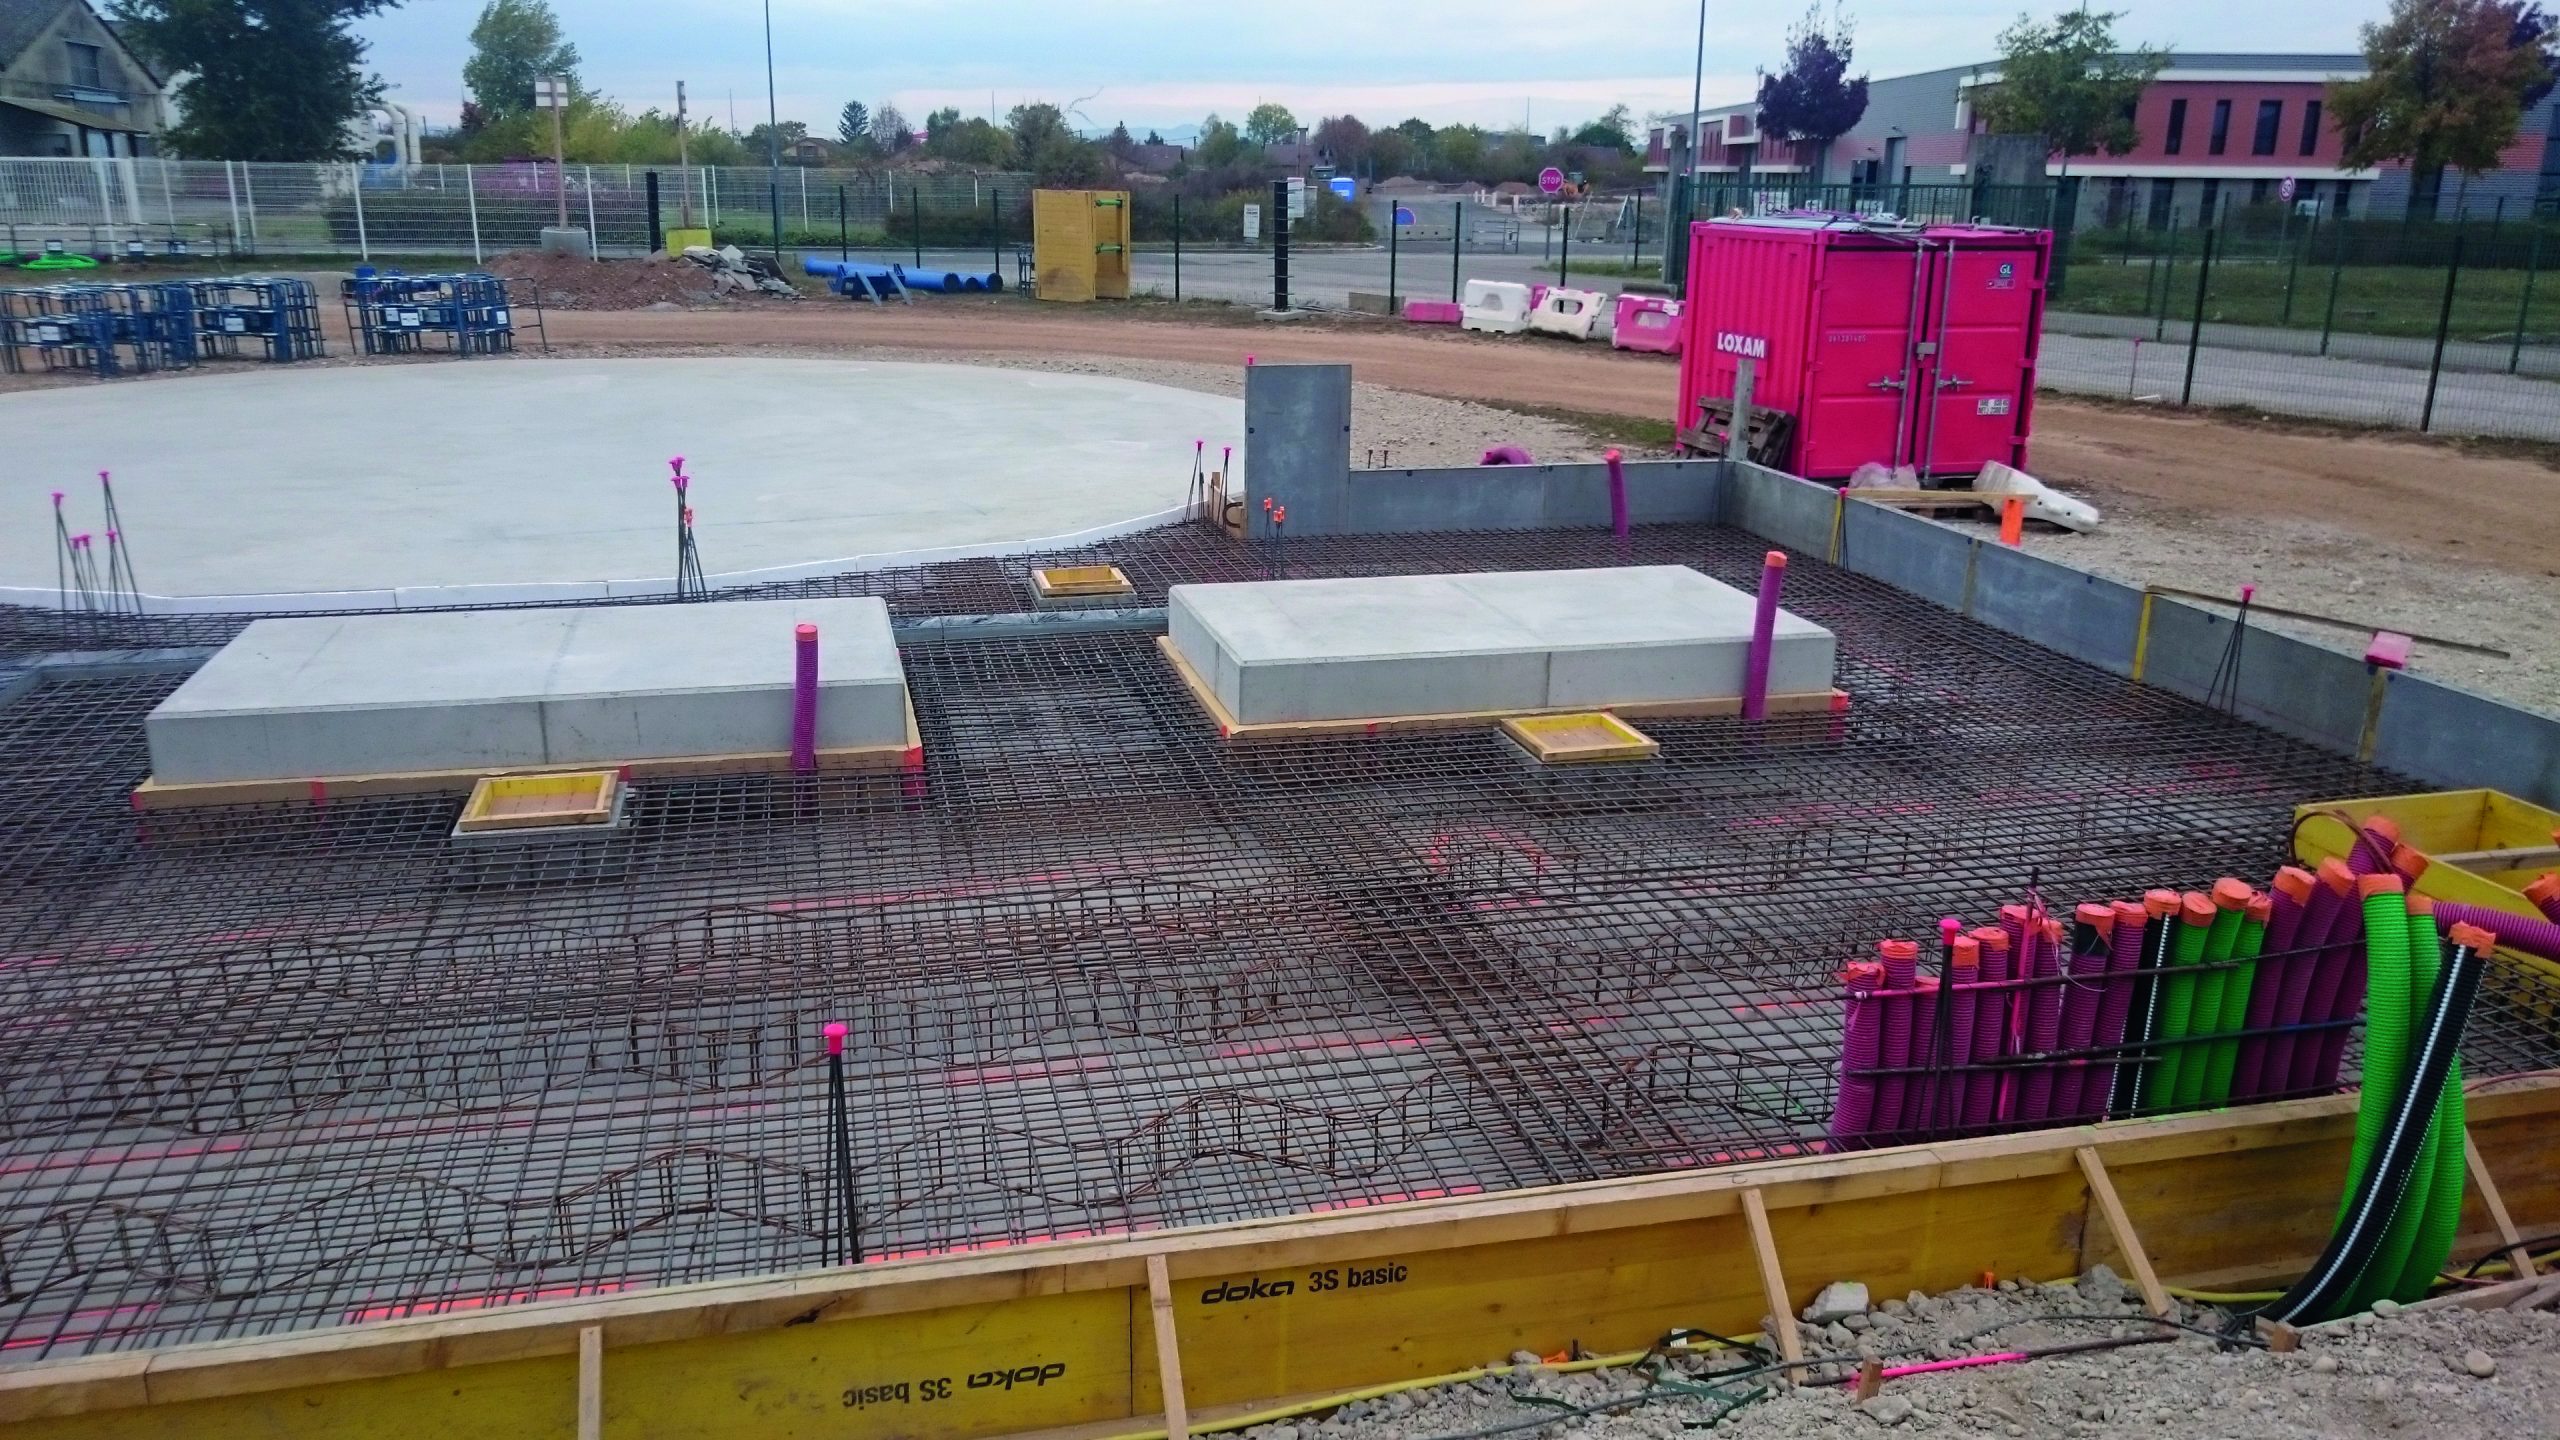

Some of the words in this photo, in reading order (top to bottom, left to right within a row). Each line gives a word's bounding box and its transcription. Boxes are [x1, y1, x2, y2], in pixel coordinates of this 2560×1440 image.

[1541, 176, 1561, 185] STOP
[1717, 332, 1765, 358] LOXAM
[1201, 1278, 1295, 1304] doka
[1308, 1269, 1339, 1293] 3S
[1347, 1262, 1408, 1289] basic
[919, 1377, 952, 1402] 3S
[966, 1362, 1066, 1390] doka
[842, 1382, 910, 1411] basic
